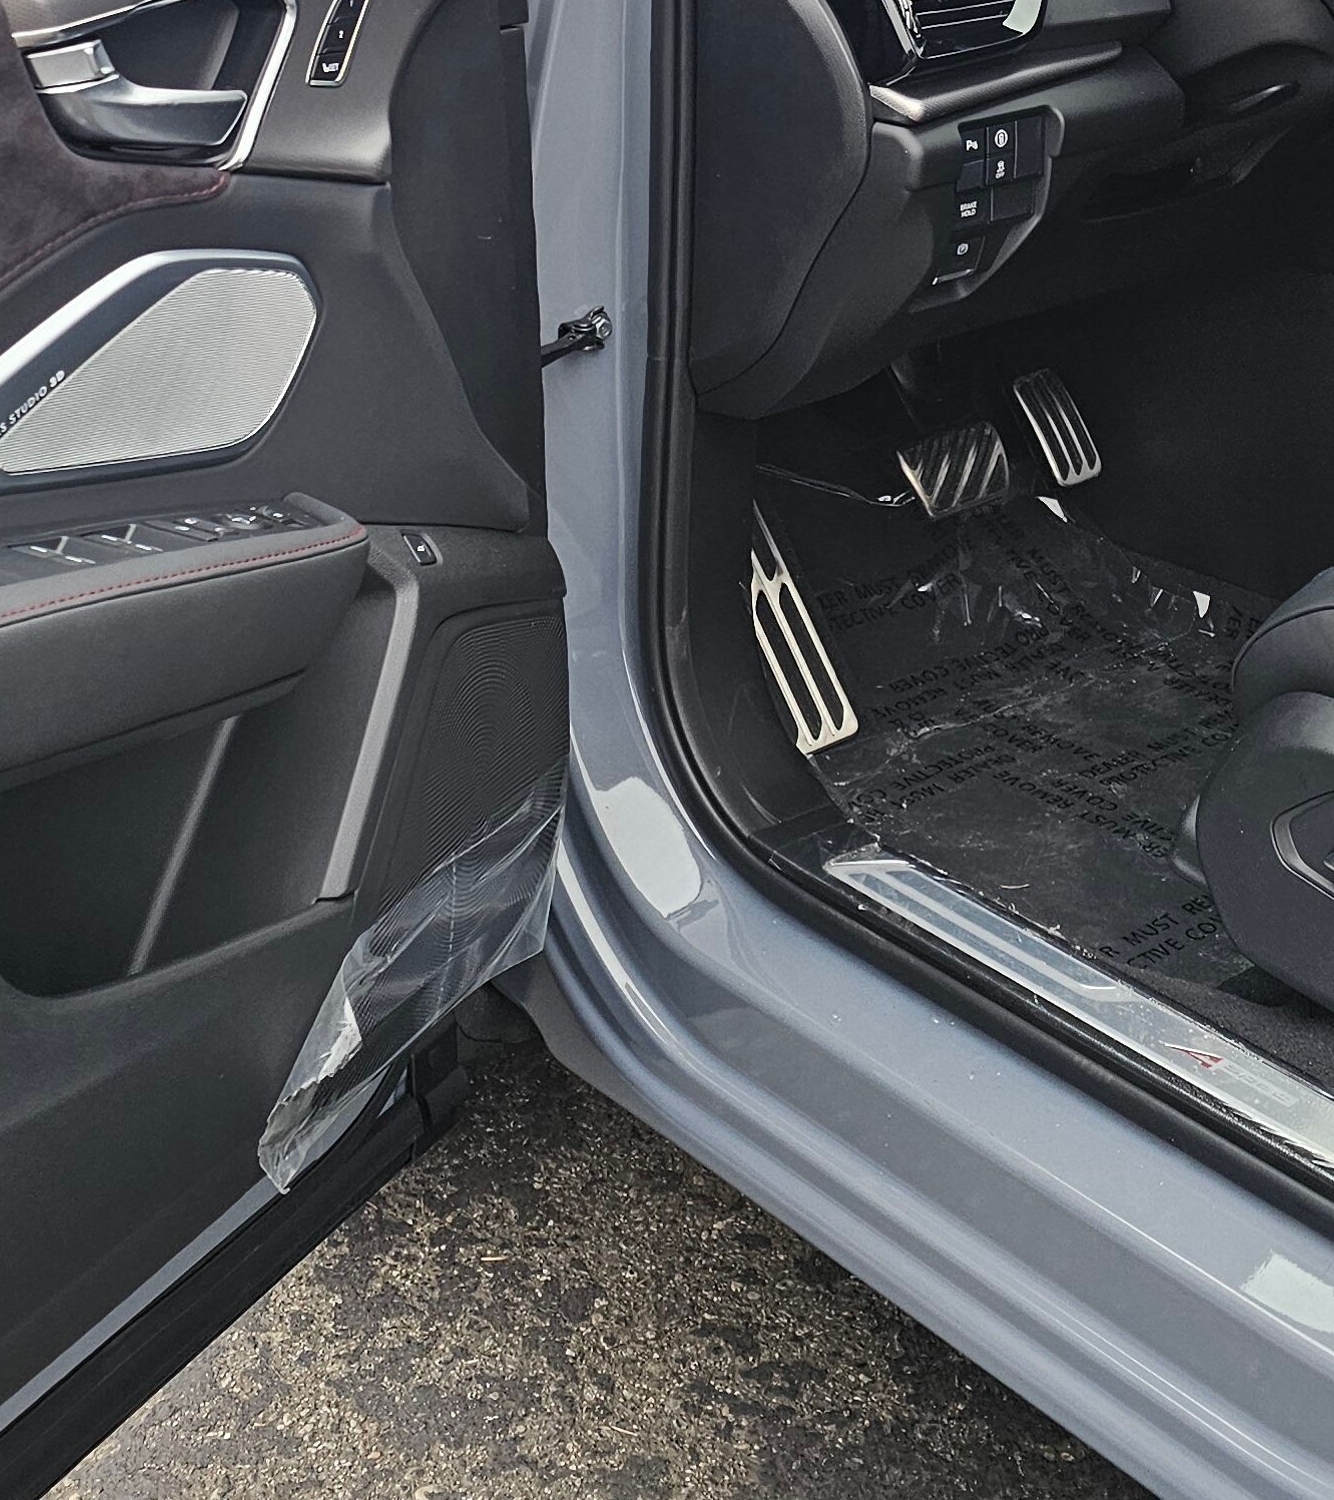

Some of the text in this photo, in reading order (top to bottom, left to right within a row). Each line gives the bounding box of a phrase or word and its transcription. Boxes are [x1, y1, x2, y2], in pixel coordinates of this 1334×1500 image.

[9, 386, 48, 425] STUDIO
[901, 572, 964, 611] COVER
[888, 665, 950, 693] COVER
[892, 744, 996, 791] PROTECTIVE
[992, 769, 1075, 811] REMOVE
[1122, 911, 1180, 947] MUST
